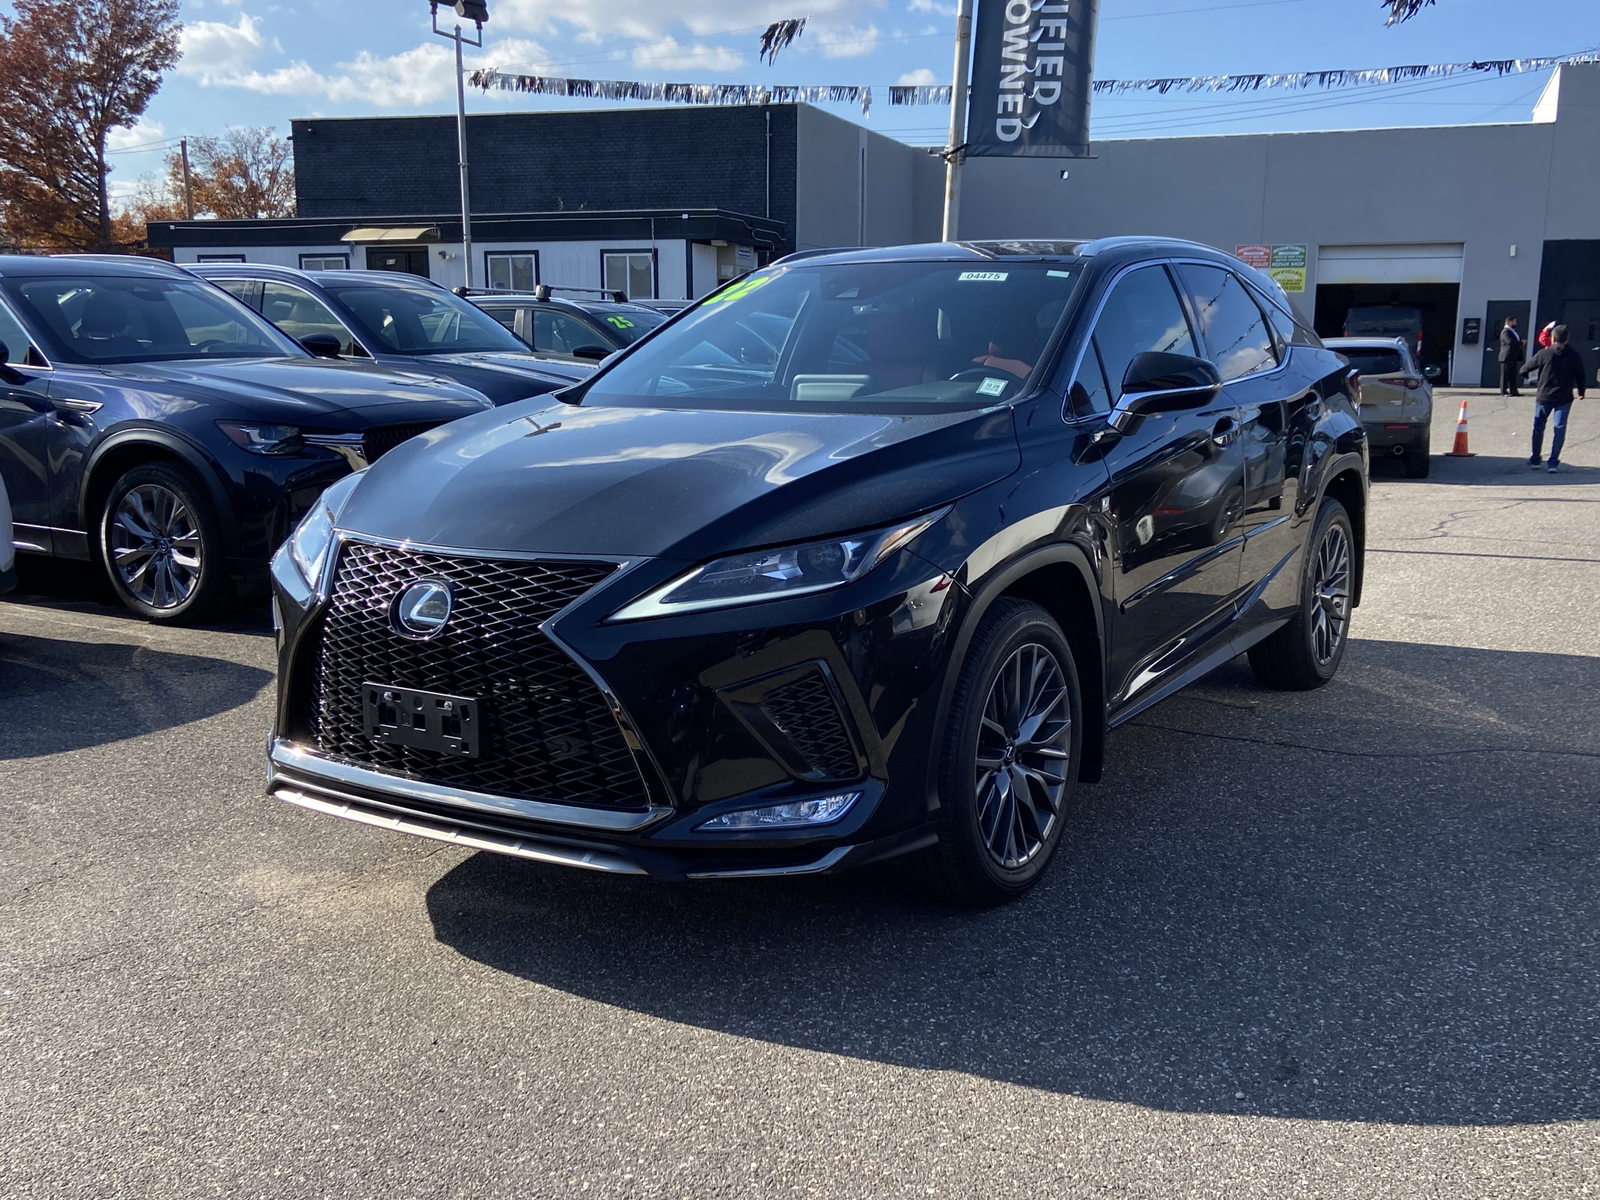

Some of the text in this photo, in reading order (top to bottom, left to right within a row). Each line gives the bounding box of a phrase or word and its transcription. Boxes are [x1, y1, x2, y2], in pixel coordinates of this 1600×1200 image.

[1034, 0, 1069, 106] IFIED
[995, 0, 1032, 142] OWNED
[967, 272, 1000, 280] 04475
[1272, 269, 1303, 277] OFFICIAL
[701, 276, 770, 306] 22
[606, 315, 636, 329] 25
